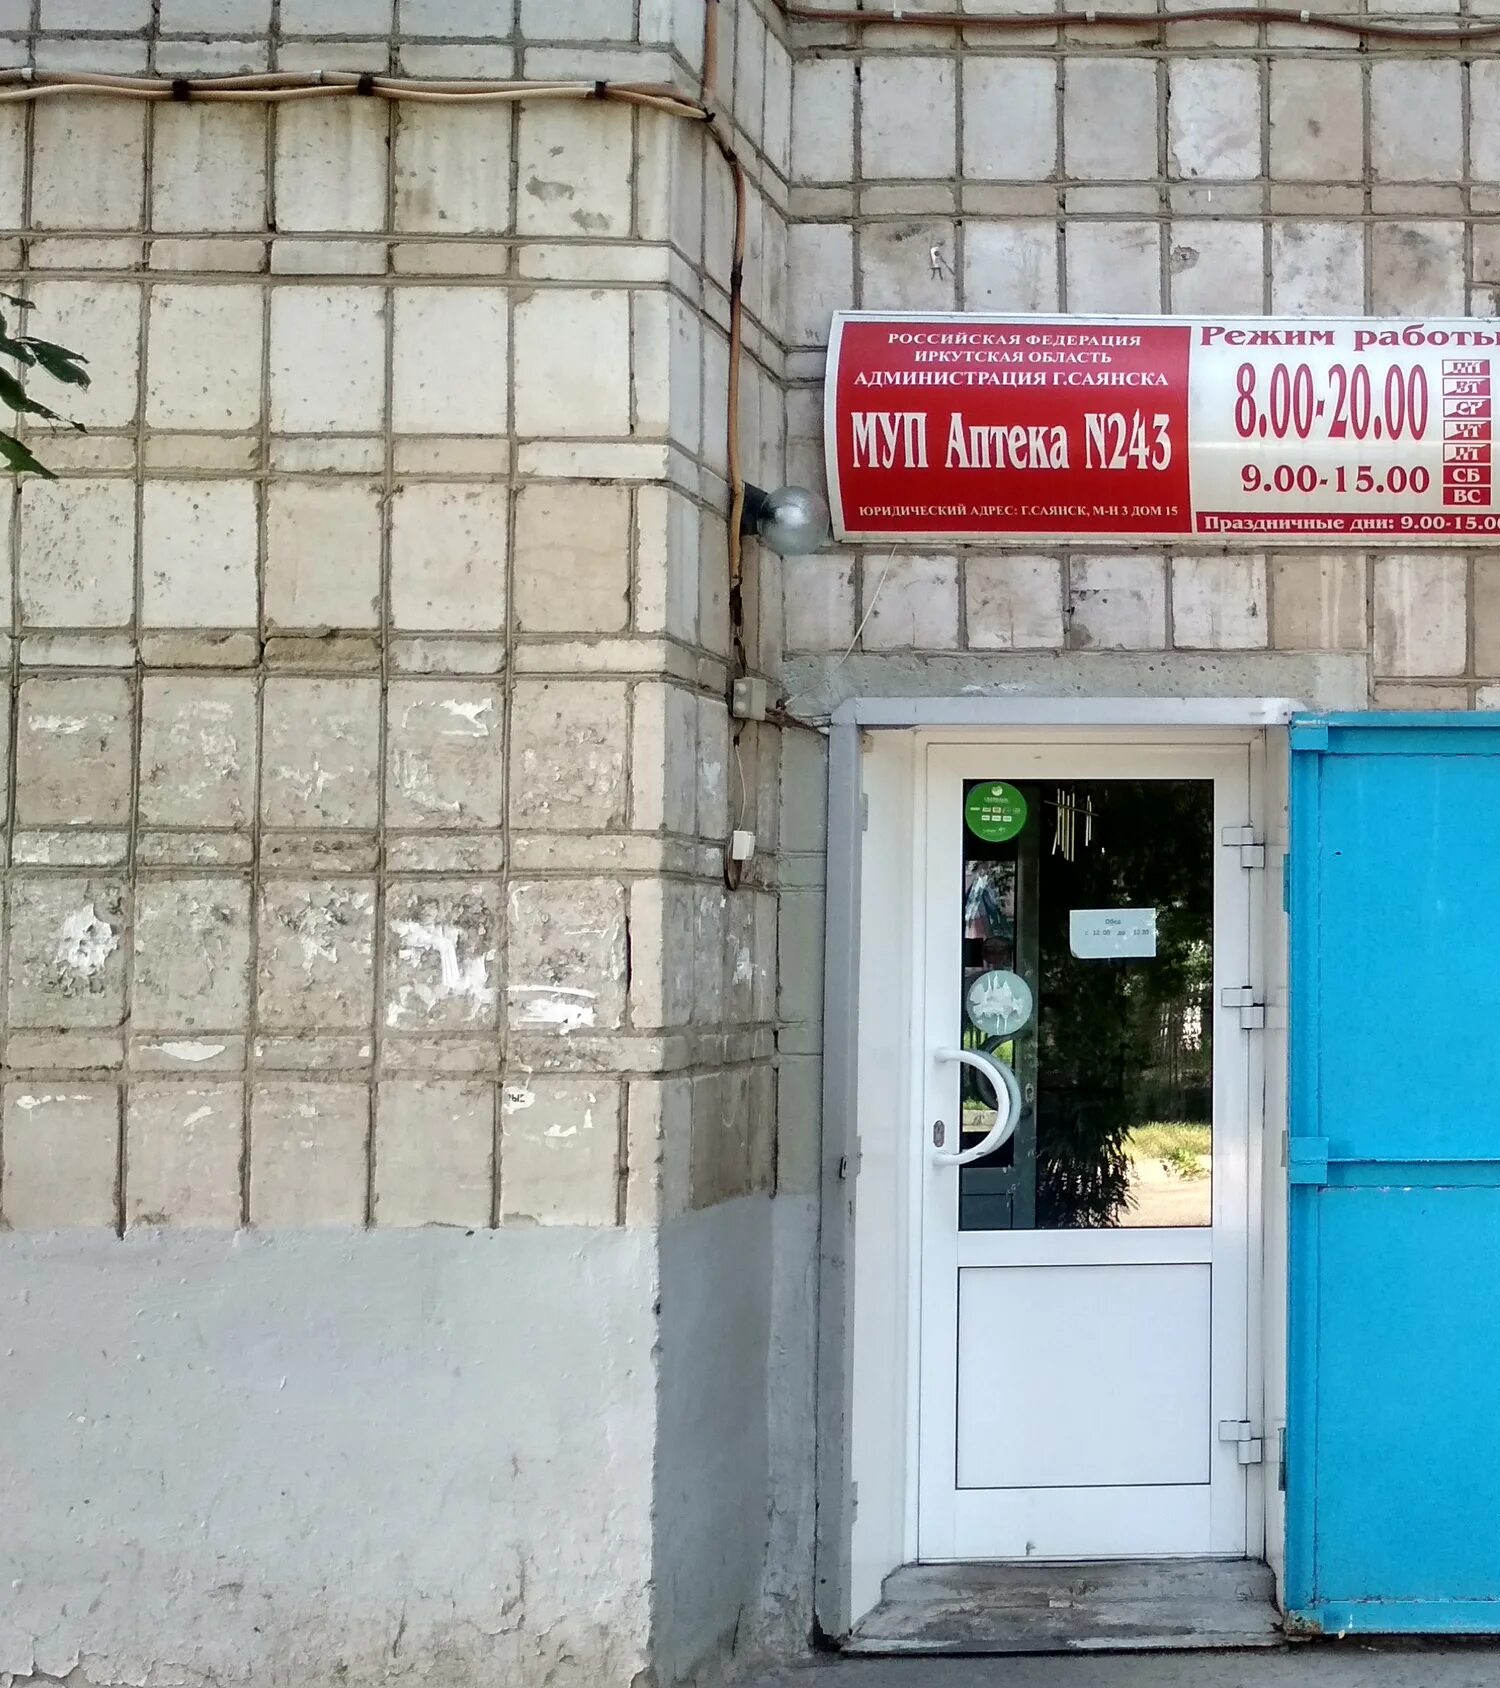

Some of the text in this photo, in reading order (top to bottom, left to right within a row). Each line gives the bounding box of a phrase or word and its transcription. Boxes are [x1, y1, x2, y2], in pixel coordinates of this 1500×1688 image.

[888, 331, 1142, 347] РОССИЙСКАЯ ФЕДЕРАЦИЯ
[1200, 326, 1335, 347] Режим
[914, 350, 1112, 364] ИРКУТСКАЯ ОБЛАСТЬ
[1452, 361, 1481, 374] ПН
[854, 371, 1169, 388] АДМИНИСТРАЦИЯ Г.САЯНСКА
[1455, 380, 1481, 394] ВТ
[1234, 362, 1429, 441] 8.00-20.00
[1455, 401, 1483, 416] СР
[1454, 423, 1482, 438] ЧТ
[850, 411, 929, 469] МУП
[944, 412, 1070, 470] Аптека
[1454, 446, 1480, 461] ПТ
[1241, 464, 1430, 494] 9.00-15.00
[1452, 468, 1481, 483] СБ
[1453, 489, 1481, 504] ВС
[859, 503, 1178, 518] ЮРИДИЧЕСКИЙ АДРЕС: Г.САЯНСК, М-Н 3 ДОМ 15
[1204, 516, 1345, 533] Праздничные
[1349, 518, 1394, 532] дни:
